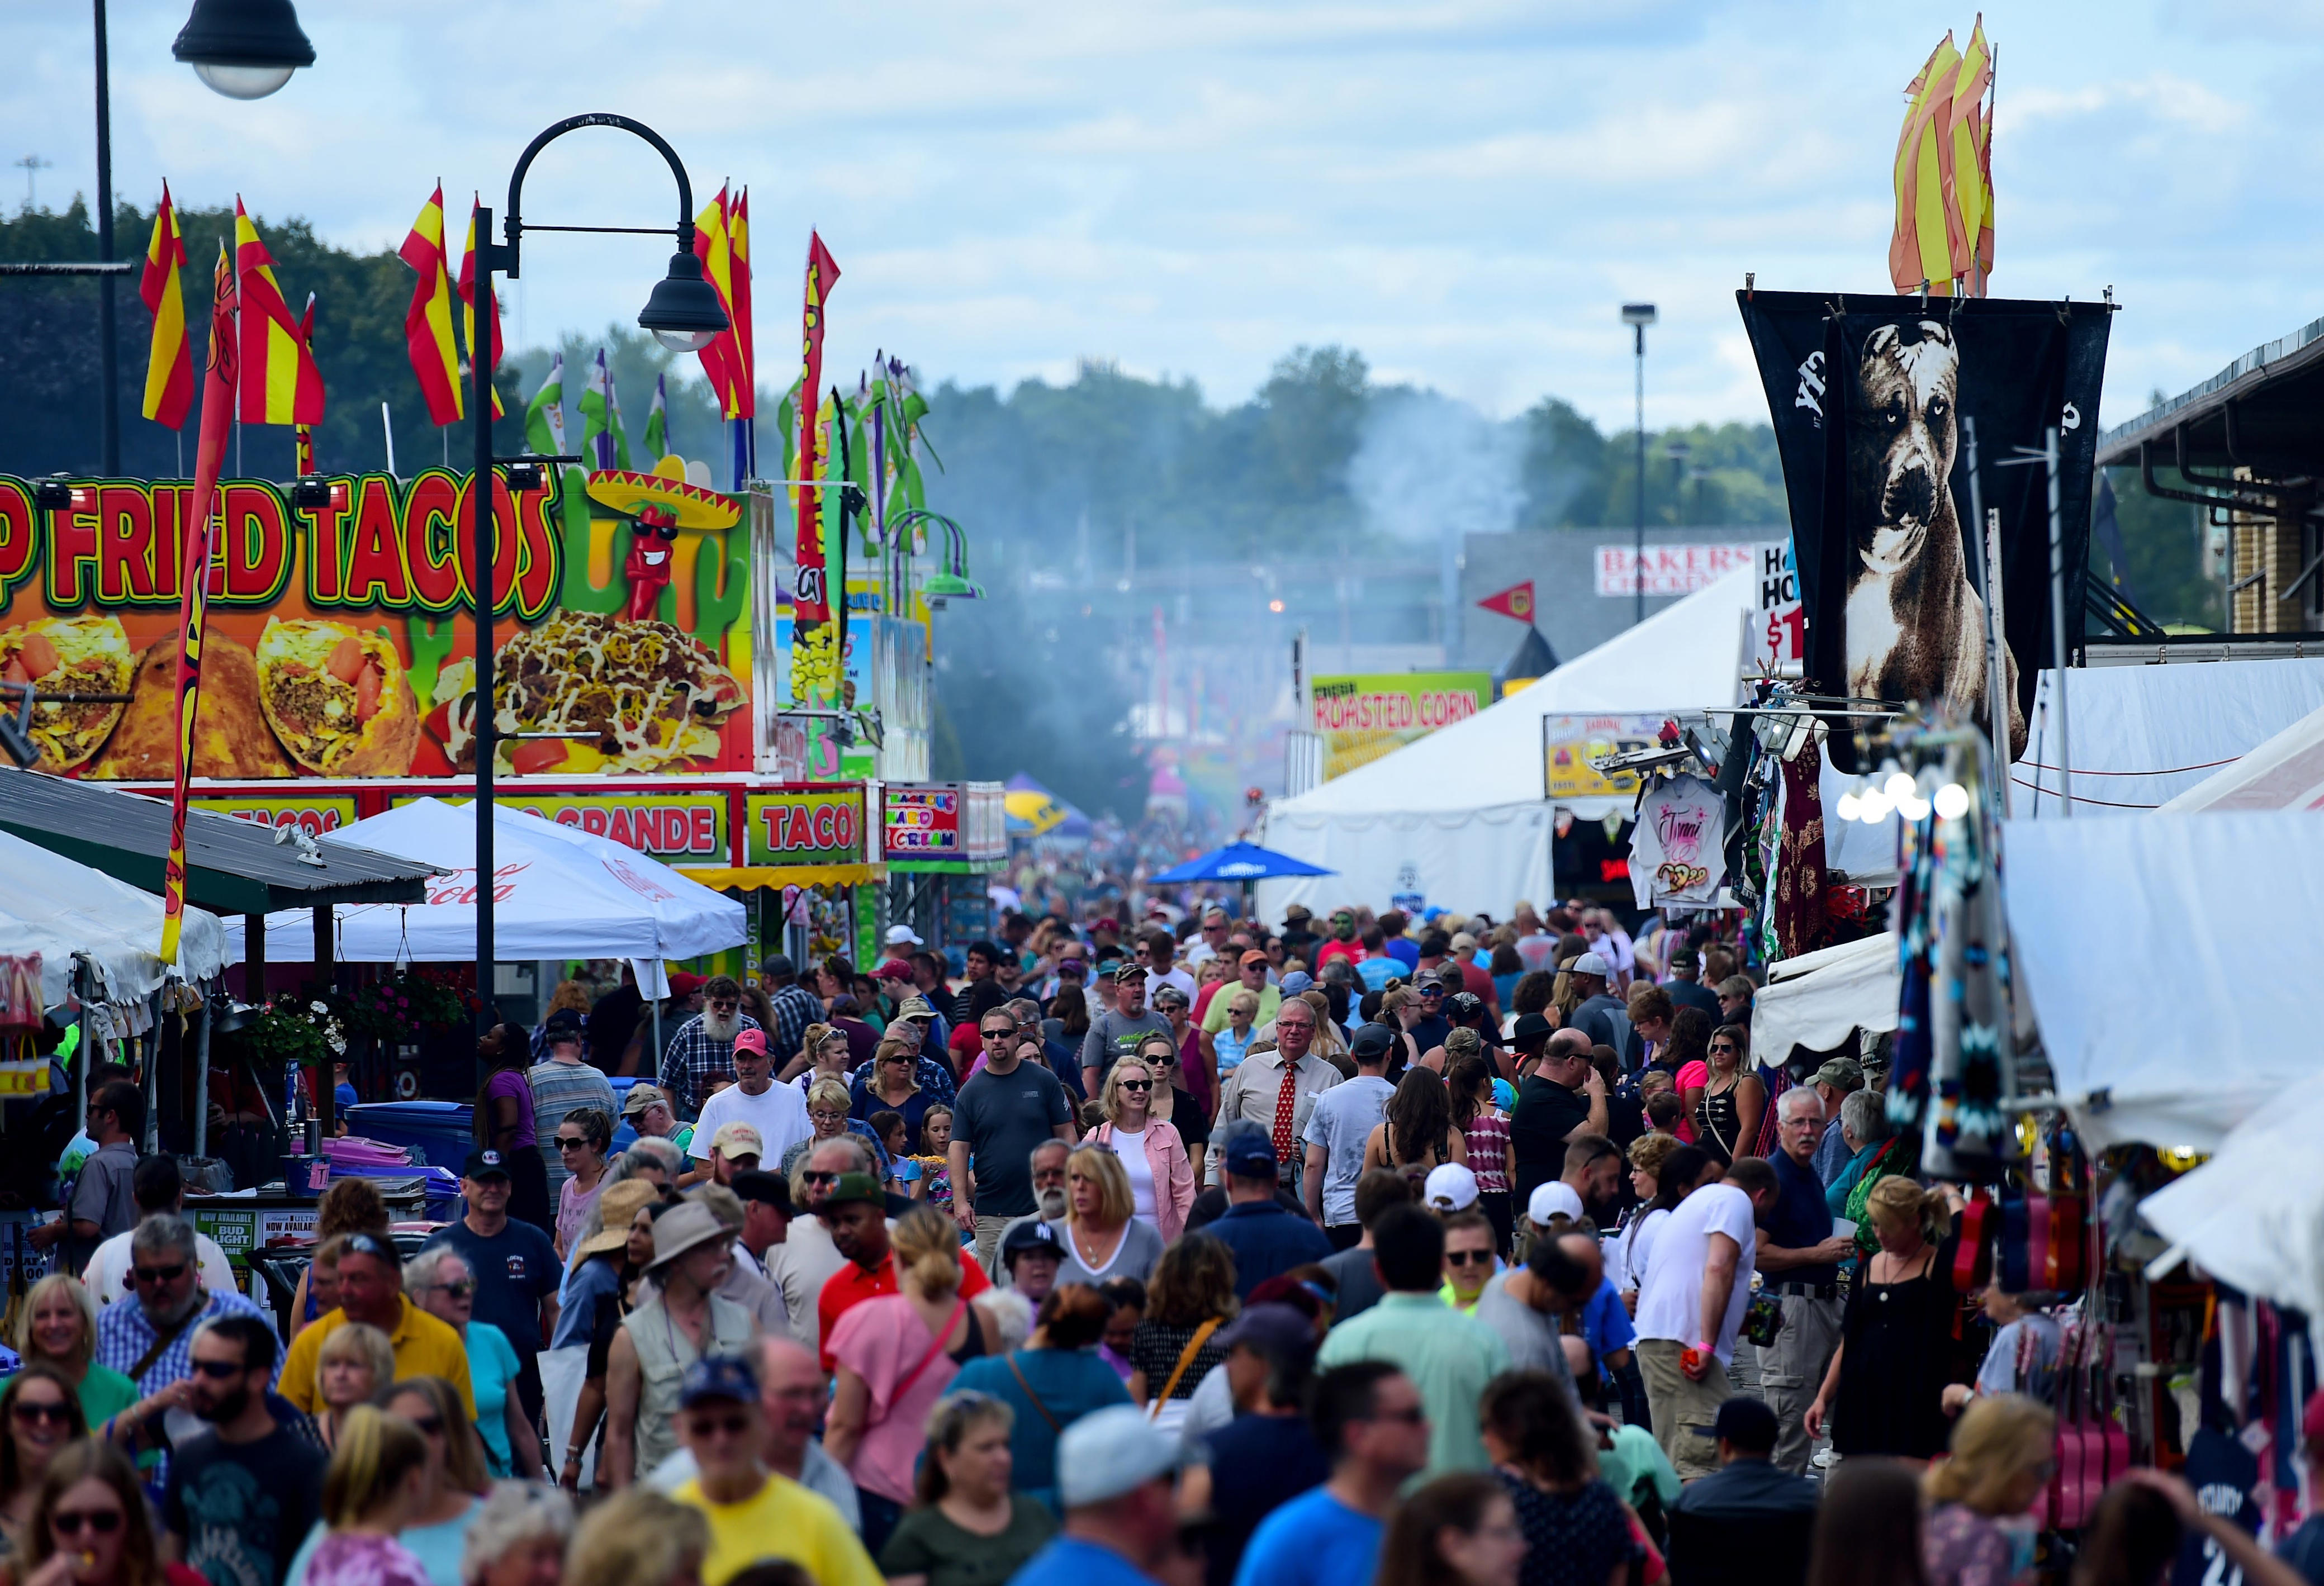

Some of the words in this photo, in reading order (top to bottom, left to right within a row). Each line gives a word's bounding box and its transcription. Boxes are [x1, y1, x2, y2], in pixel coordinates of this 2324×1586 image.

[48, 481, 291, 605] FRIED
[298, 468, 562, 618] TACOS
[1604, 546, 1752, 571] BAKERS
[1765, 548, 1787, 576] H
[1762, 574, 1795, 610] HO
[1315, 693, 1412, 729] ROASTED
[1419, 690, 1477, 726] CORN
[888, 792, 956, 814] RAGEOUS
[761, 803, 859, 851] TACOS
[894, 829, 957, 849] CREAM
[201, 1213, 216, 1221] NOW
[218, 1213, 252, 1223] AVAILABLE
[266, 1222, 282, 1231] NOW
[284, 1222, 316, 1231] AVAILAB
[214, 1235, 249, 1244] LIGHT
[219, 1226, 244, 1235] BUD
[4, 1257, 46, 1266] DAF
